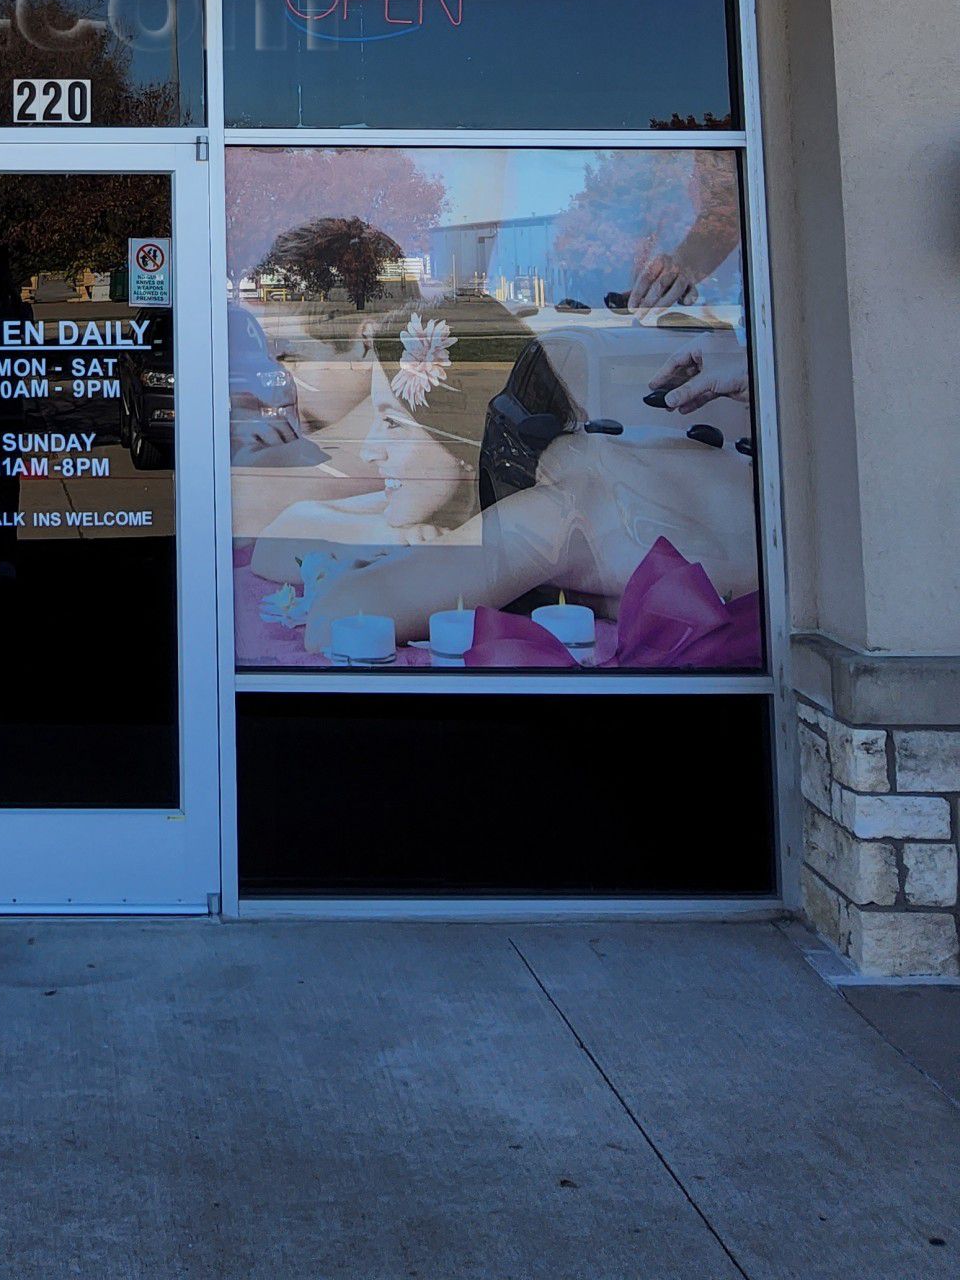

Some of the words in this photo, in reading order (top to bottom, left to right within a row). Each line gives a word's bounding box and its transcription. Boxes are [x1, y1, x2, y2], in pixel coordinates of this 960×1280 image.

[15, 80, 89, 121] 220
[58, 320, 151, 346] DAILY
[71, 358, 118, 377] SAT
[72, 379, 121, 398] 9PM
[1, 433, 97, 452] SUNDAY
[33, 511, 62, 527] INS
[65, 511, 153, 526] WELCOME
